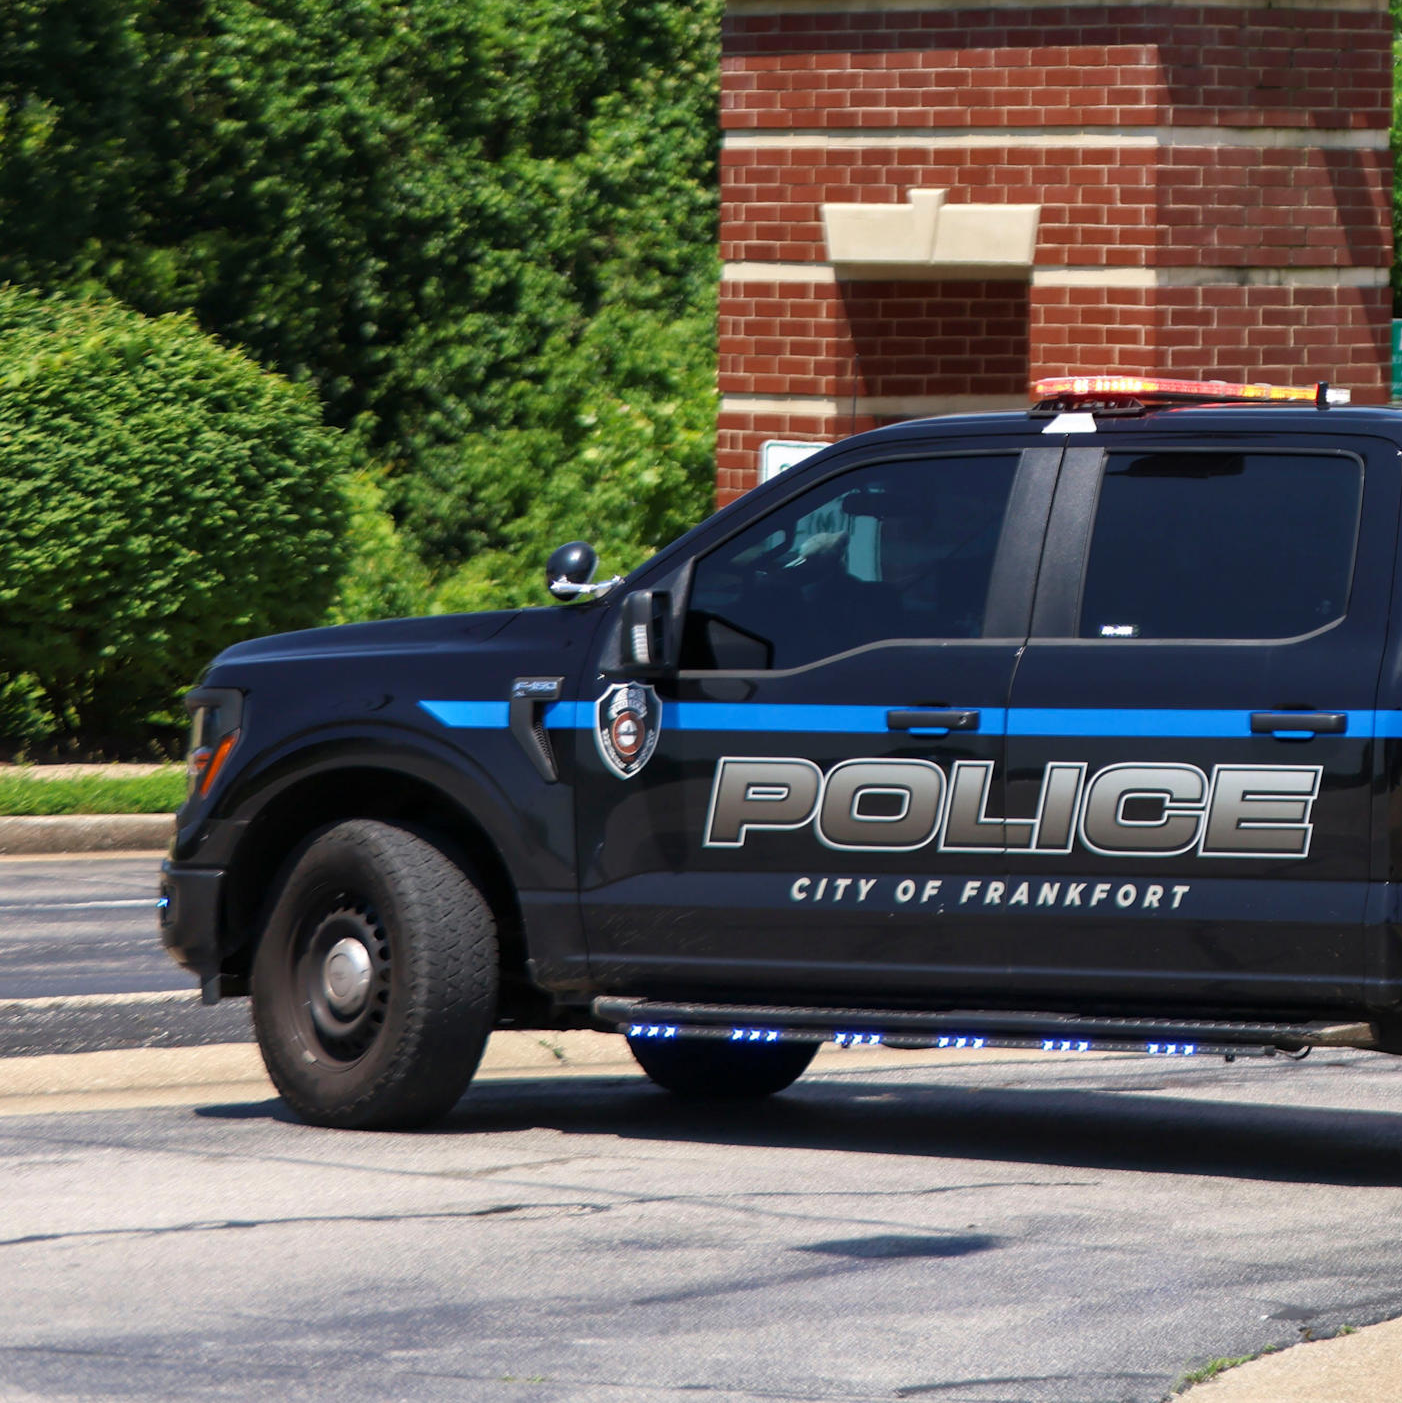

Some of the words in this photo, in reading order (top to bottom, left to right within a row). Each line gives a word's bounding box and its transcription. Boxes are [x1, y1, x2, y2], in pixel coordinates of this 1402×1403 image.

[512, 681, 558, 692] F-150
[703, 756, 1324, 858] POLICE
[790, 877, 877, 902] CITY
[895, 879, 942, 903] OF
[959, 881, 1191, 908] FRANKFORT
